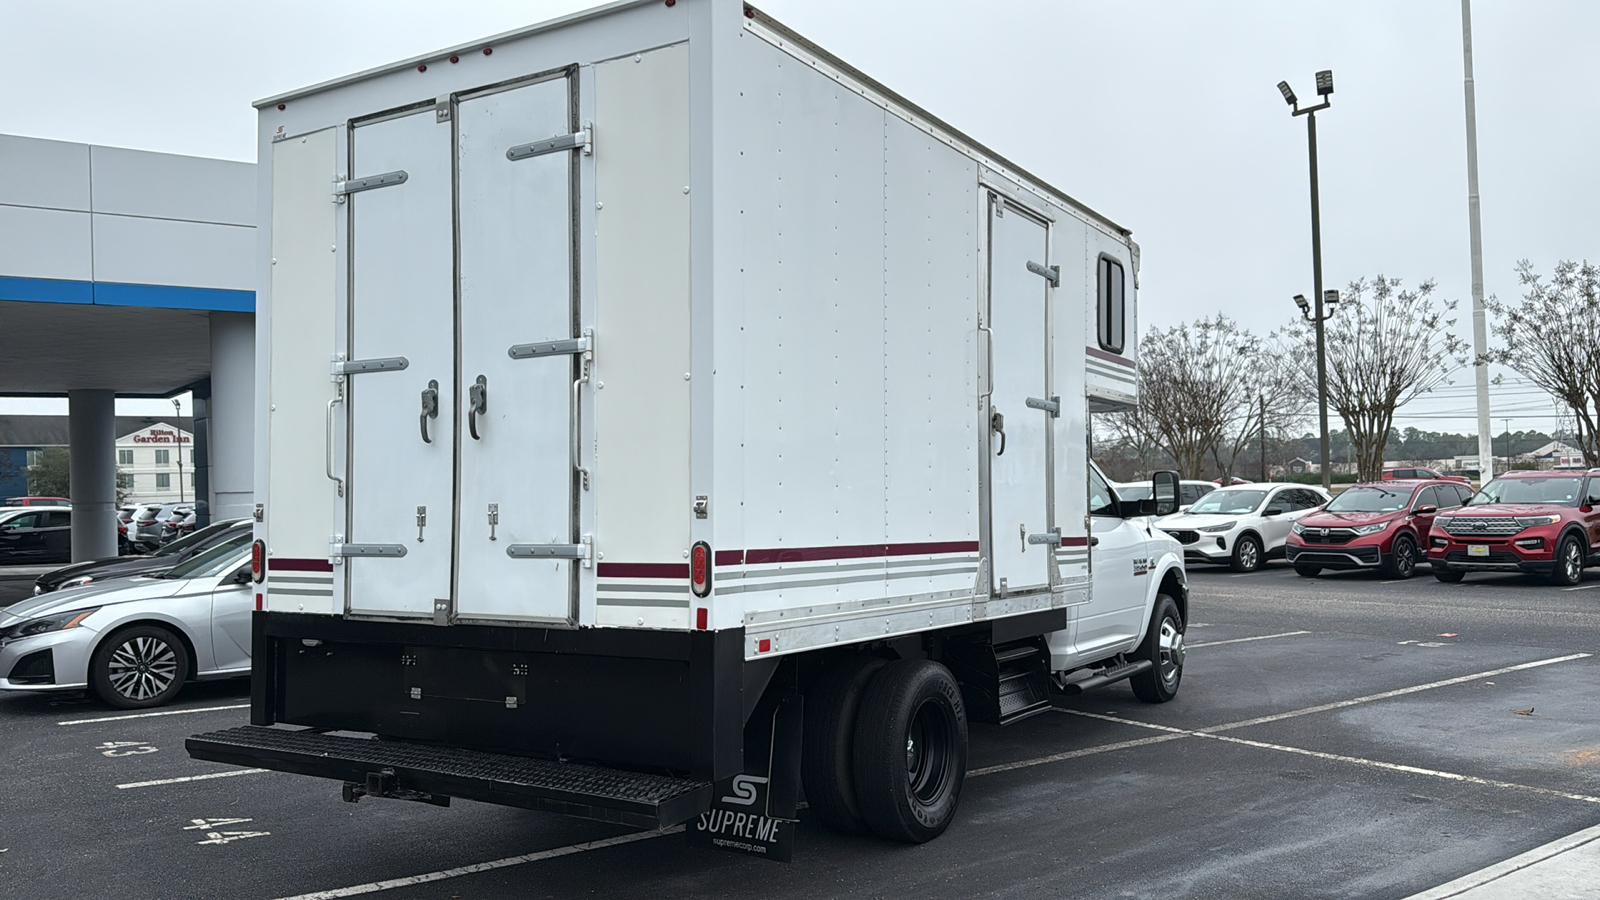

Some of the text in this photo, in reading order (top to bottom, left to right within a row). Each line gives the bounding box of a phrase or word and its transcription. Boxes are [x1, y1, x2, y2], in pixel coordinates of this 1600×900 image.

[133, 434, 190, 443] Garden Inn
[697, 809, 783, 843] SUPREME
[712, 838, 767, 854] supremecorp.com
